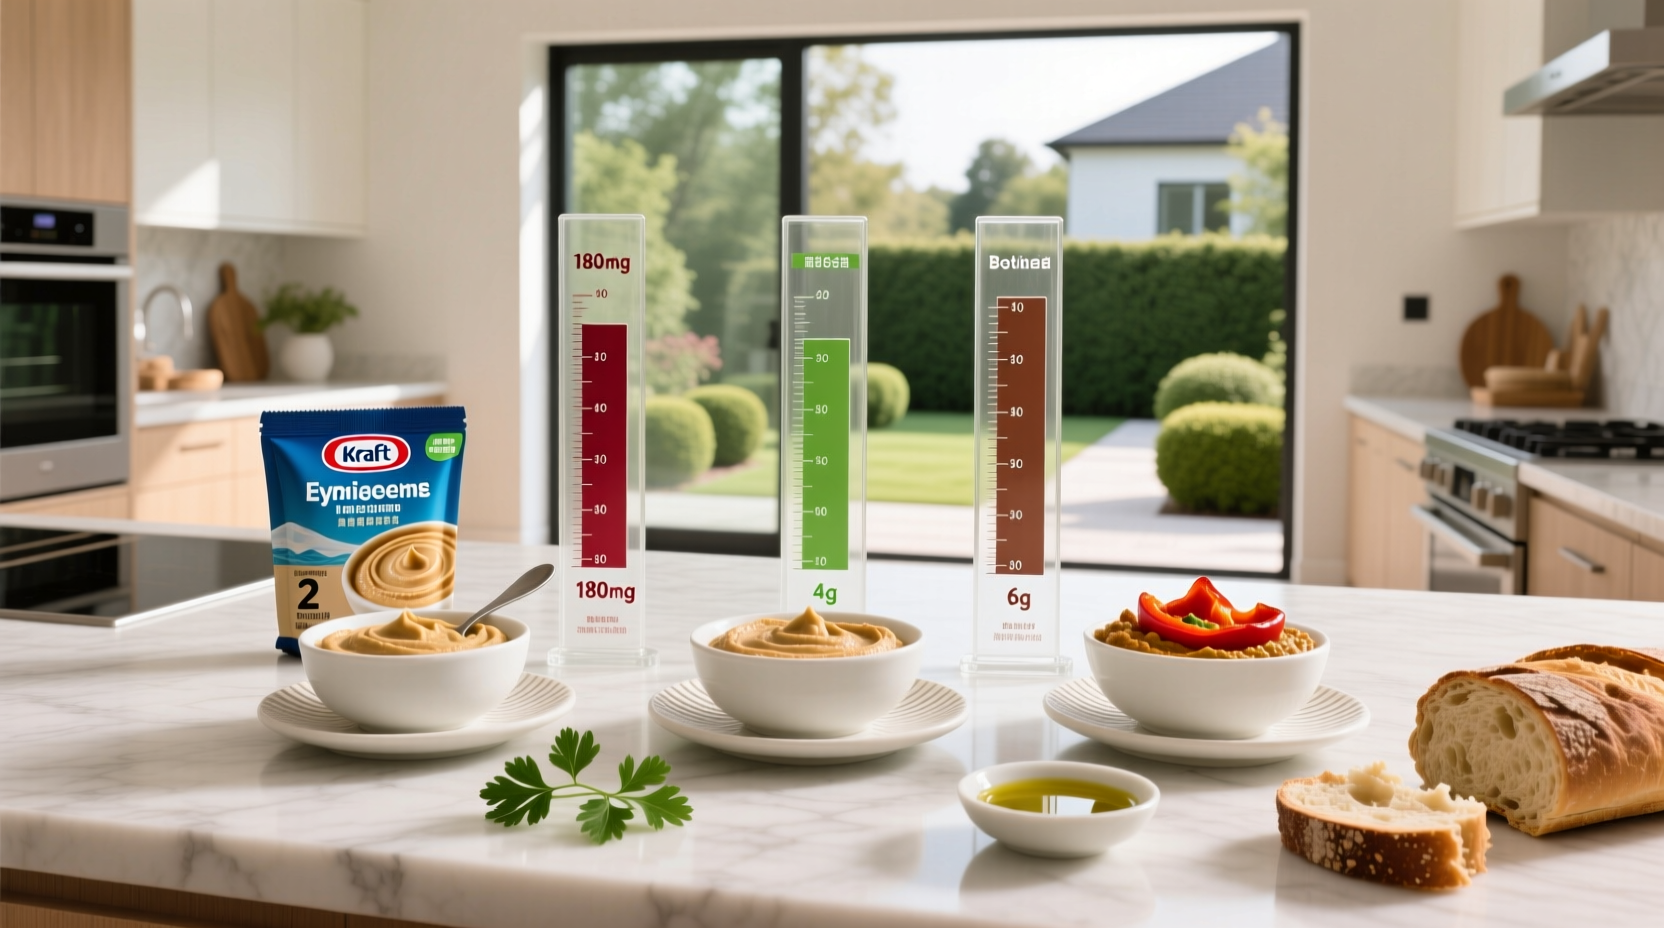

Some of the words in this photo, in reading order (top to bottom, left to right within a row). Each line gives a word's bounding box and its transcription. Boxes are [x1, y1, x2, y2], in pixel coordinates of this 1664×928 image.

[574, 252, 631, 275] 180mg
[342, 443, 392, 463] Kraft
[297, 578, 320, 610] 2
[576, 580, 636, 604] 180mg
[812, 582, 838, 606] 4g
[1007, 586, 1031, 611] 6g
